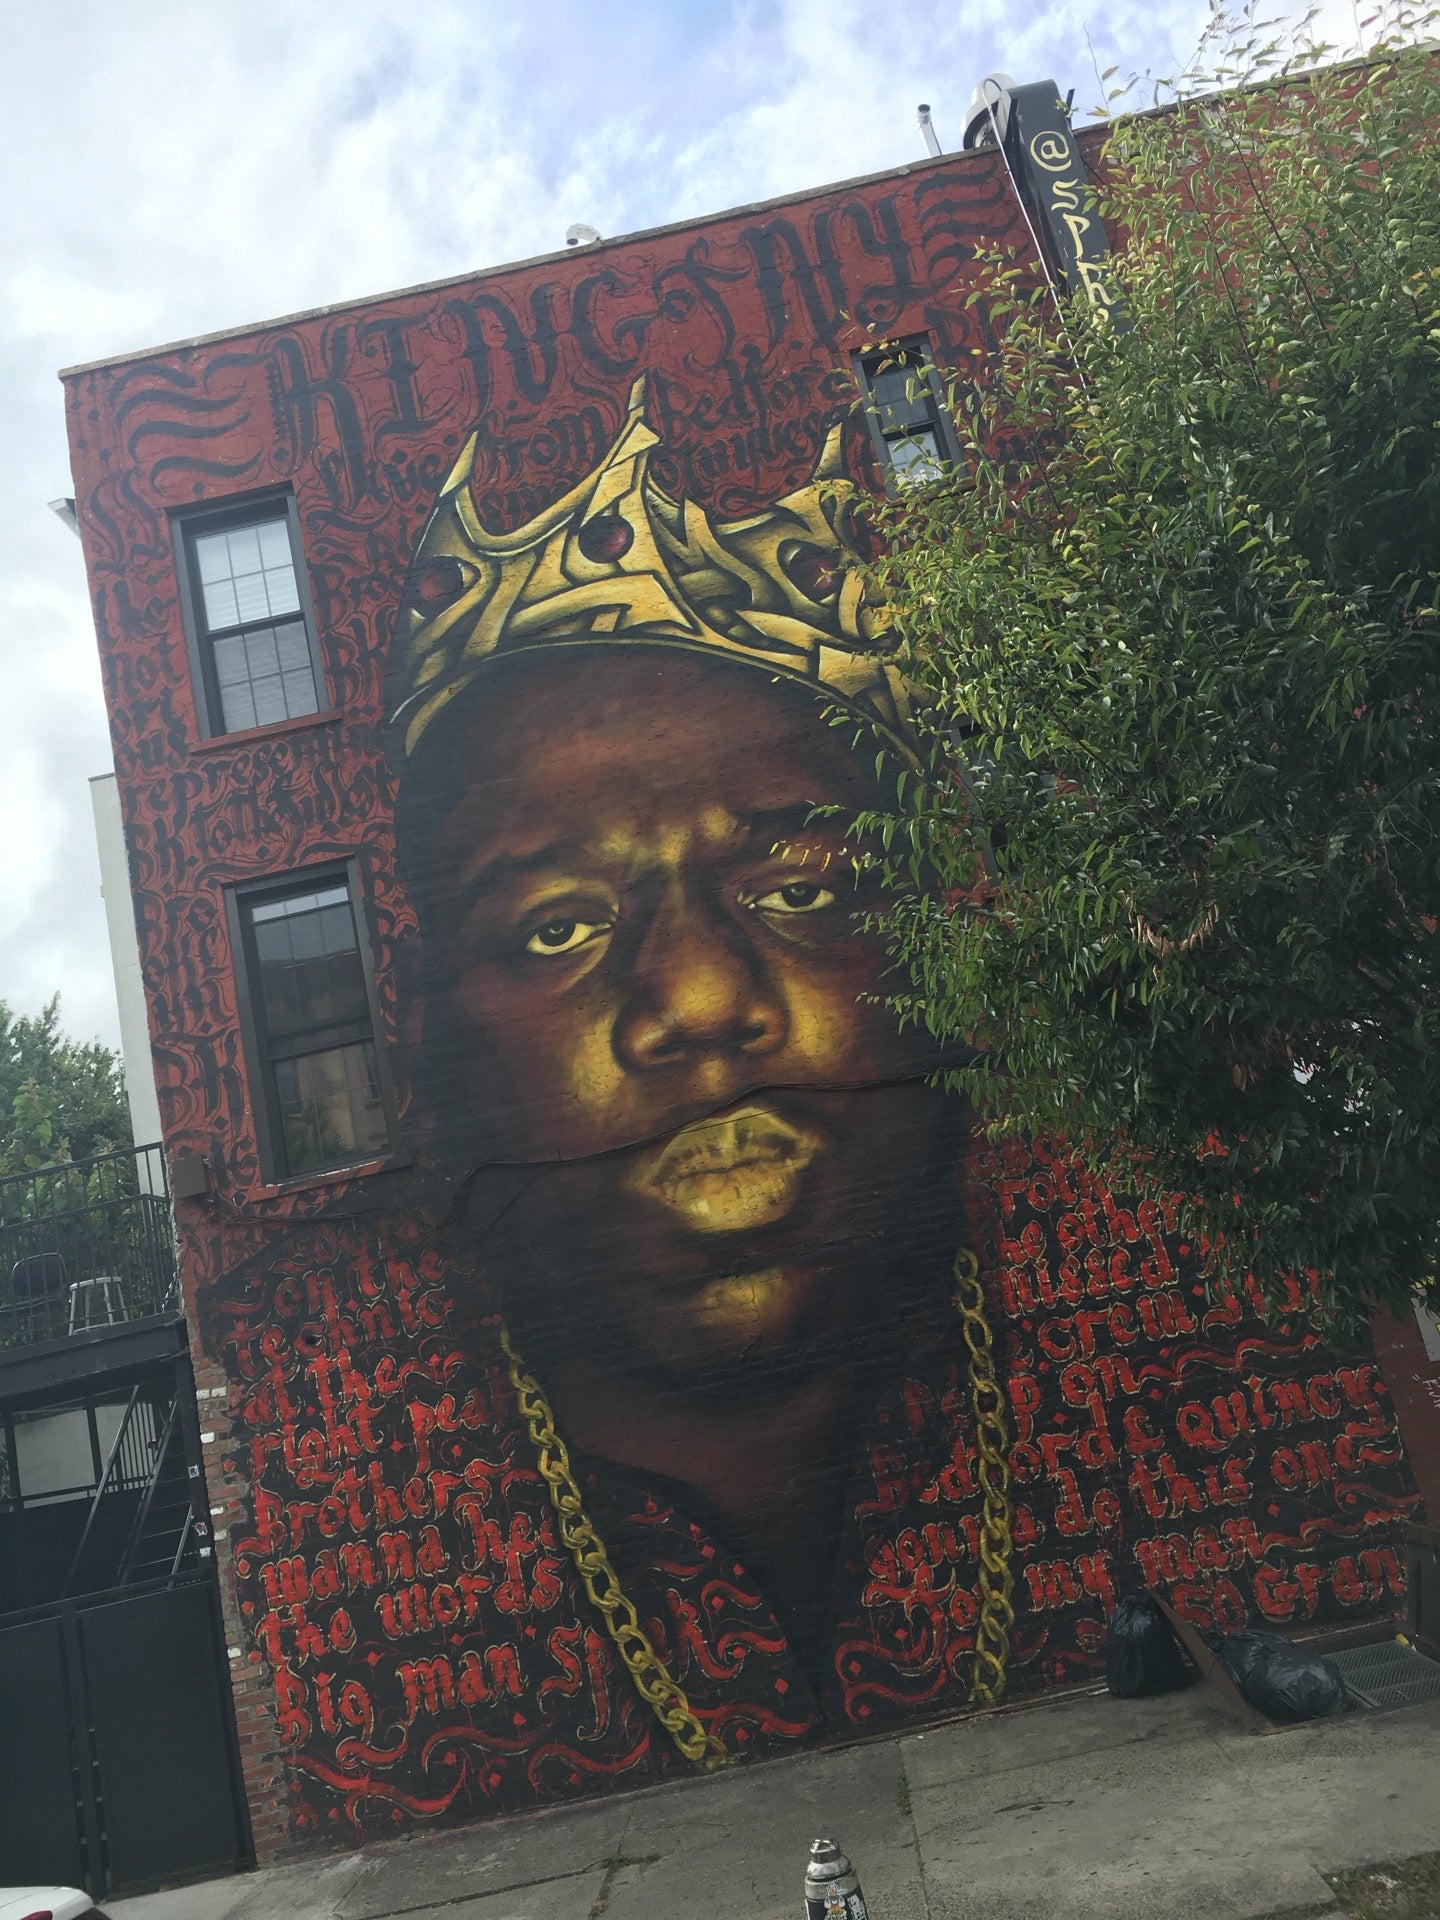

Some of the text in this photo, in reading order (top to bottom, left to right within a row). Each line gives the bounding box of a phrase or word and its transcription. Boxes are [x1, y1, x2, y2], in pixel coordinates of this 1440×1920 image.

[1037, 1290, 1198, 1362] crew
[248, 1398, 386, 1492] right
[1176, 1364, 1396, 1453] Quincy
[1129, 1448, 1256, 1520] this
[258, 1523, 450, 1612] wanna
[374, 1550, 563, 1642] words
[1133, 1517, 1264, 1588] man
[1171, 1577, 1250, 1637] 50
[1252, 1546, 1410, 1622] Gran
[396, 1641, 528, 1725] man
